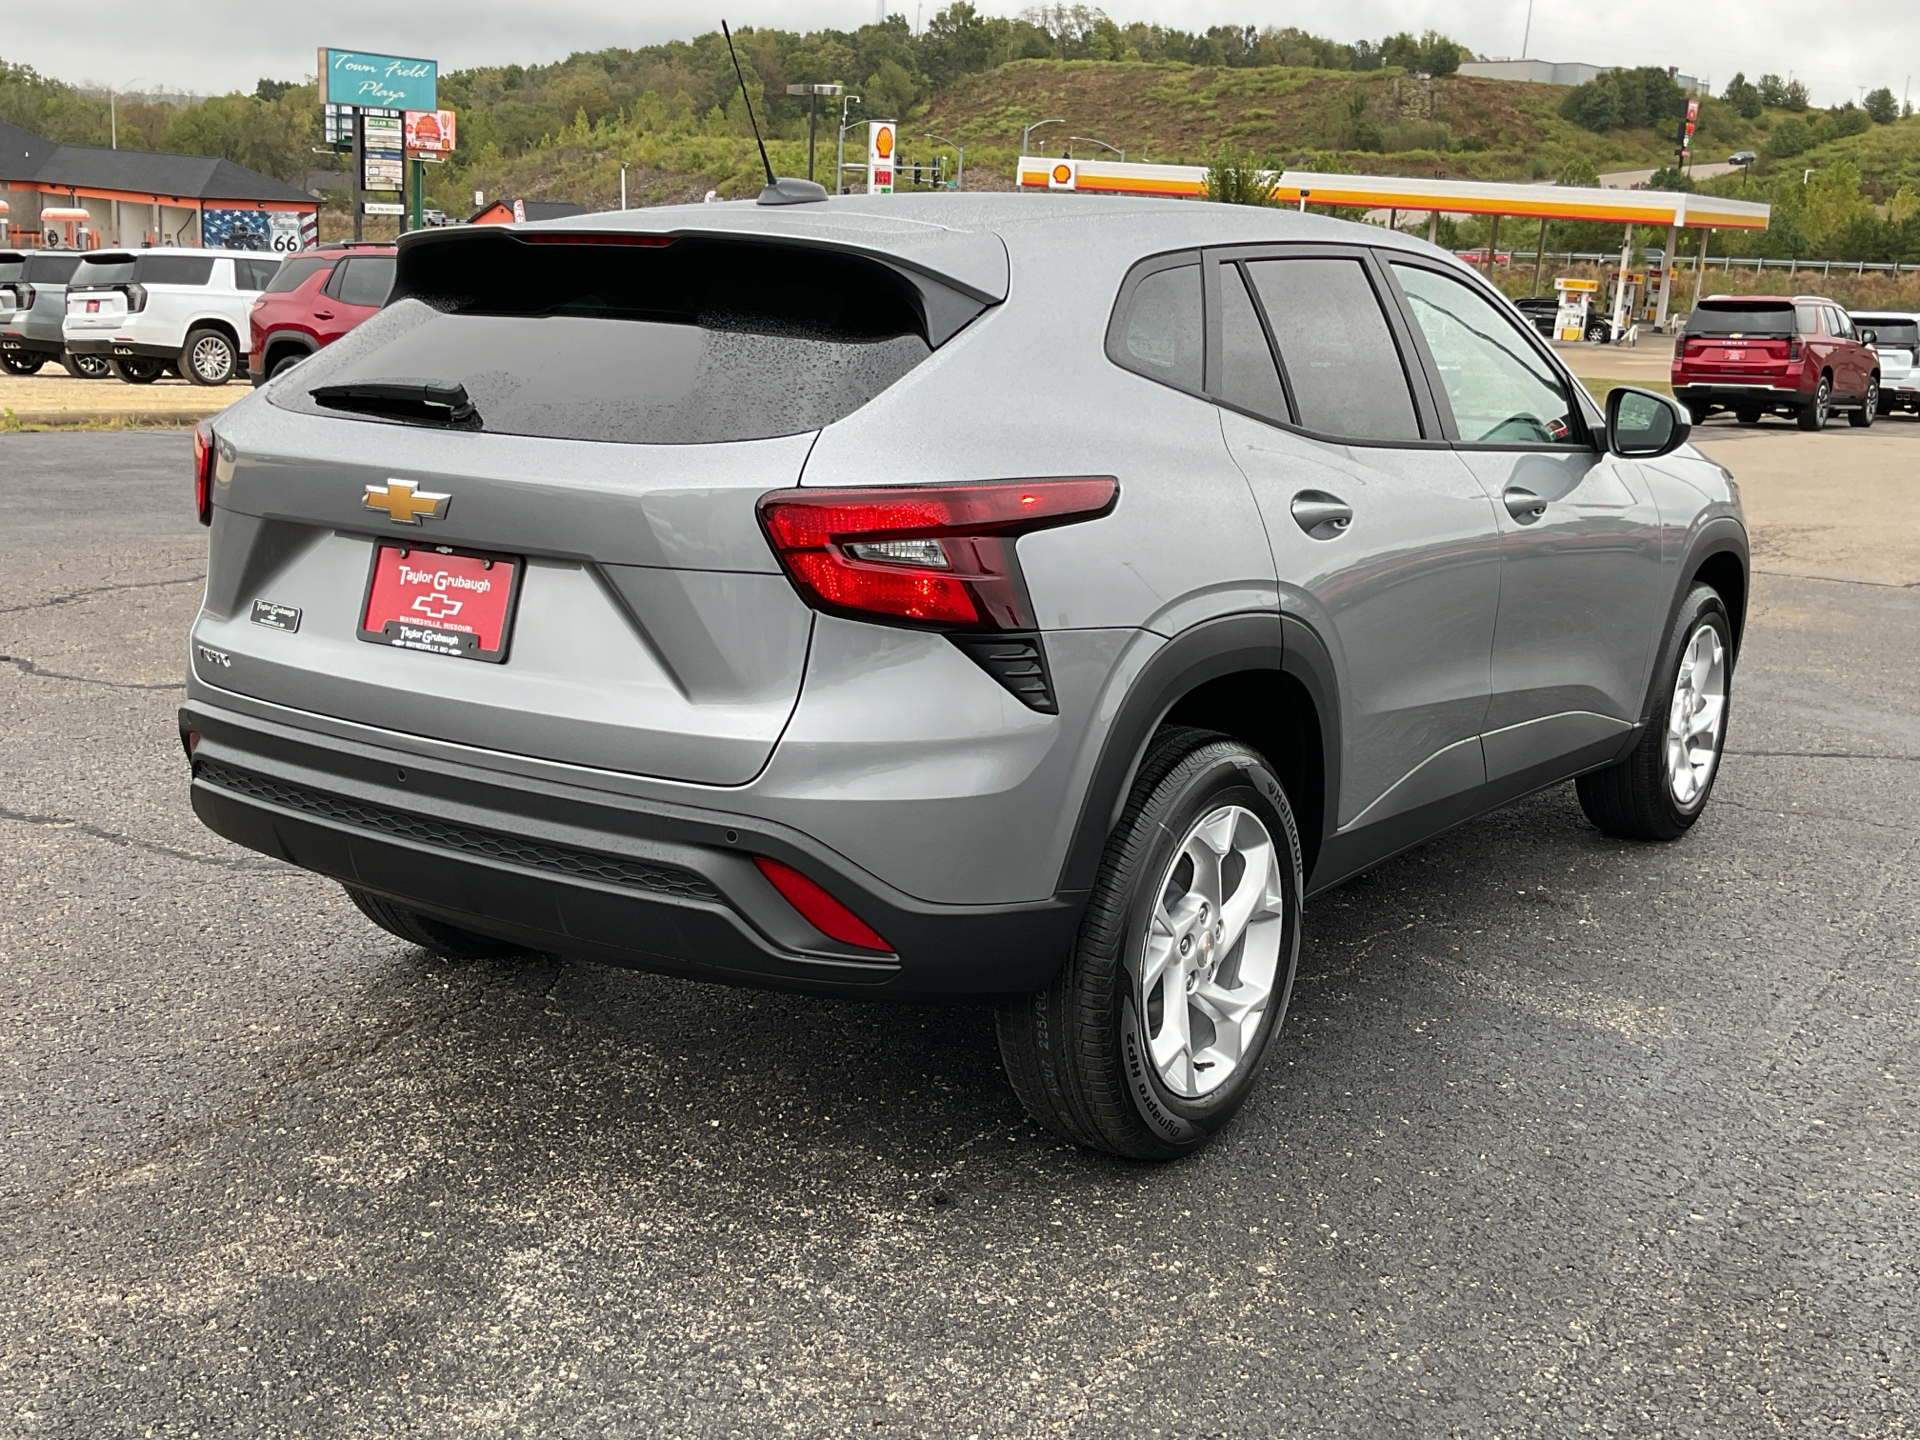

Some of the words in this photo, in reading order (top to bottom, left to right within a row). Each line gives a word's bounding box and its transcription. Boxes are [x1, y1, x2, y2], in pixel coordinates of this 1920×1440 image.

[335, 54, 377, 72] Town
[384, 60, 429, 78] Field
[358, 81, 406, 105] Plaza
[273, 235, 298, 252] 66
[398, 565, 434, 586] Taylor
[433, 570, 491, 593] Grubaugh
[399, 615, 442, 629] WAYNESVILLE,
[443, 622, 473, 633] MISSOURI
[400, 626, 423, 639] Taylor
[422, 629, 459, 645] Grubaugh
[1126, 1031, 1142, 1078] HP2
[1138, 1083, 1181, 1137] Dynapro
